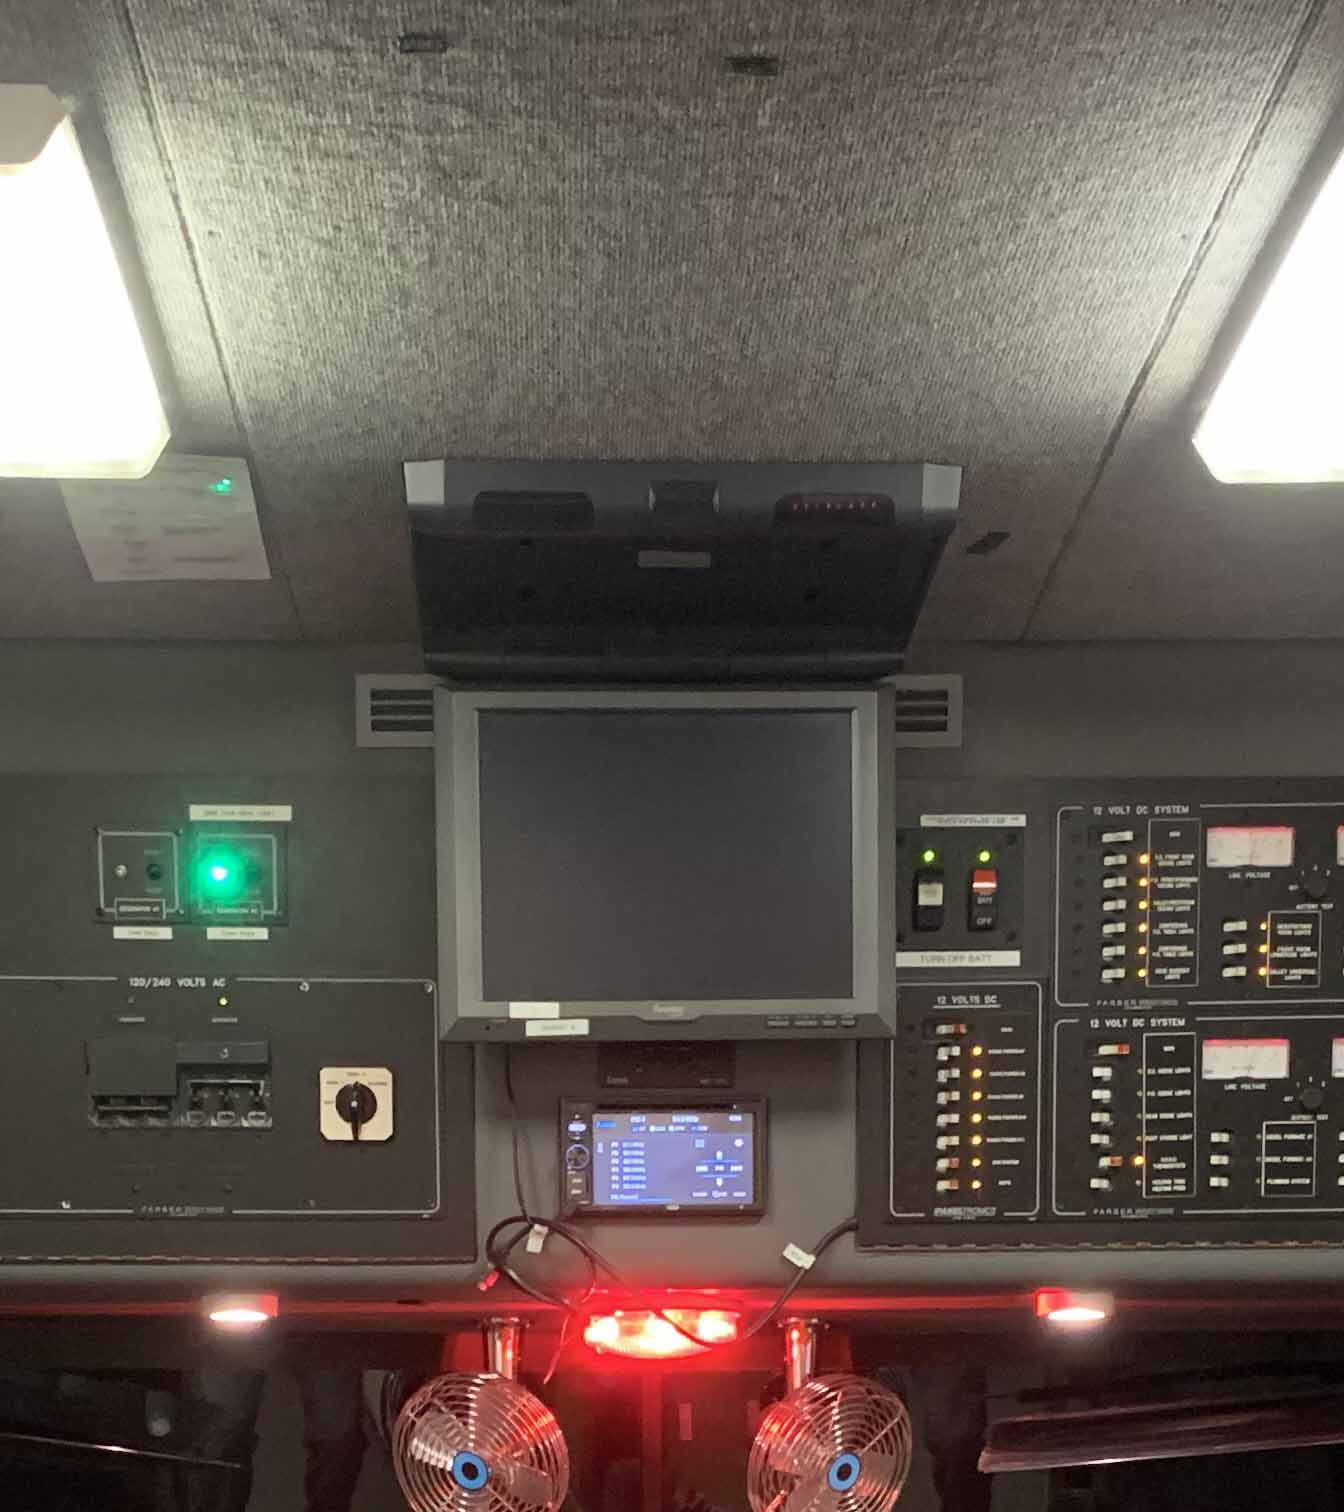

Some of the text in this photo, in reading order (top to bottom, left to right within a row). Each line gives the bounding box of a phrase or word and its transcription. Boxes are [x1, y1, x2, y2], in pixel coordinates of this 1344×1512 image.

[1093, 805, 1190, 815] 12 VOLT DC SYSTEM
[976, 917, 993, 925] OFF
[129, 977, 226, 988] 120/240 VOLTS AC
[937, 995, 998, 1005] 12 VOLTS DC
[1090, 1017, 1186, 1028] 12 VOLT DC SYSTEM
